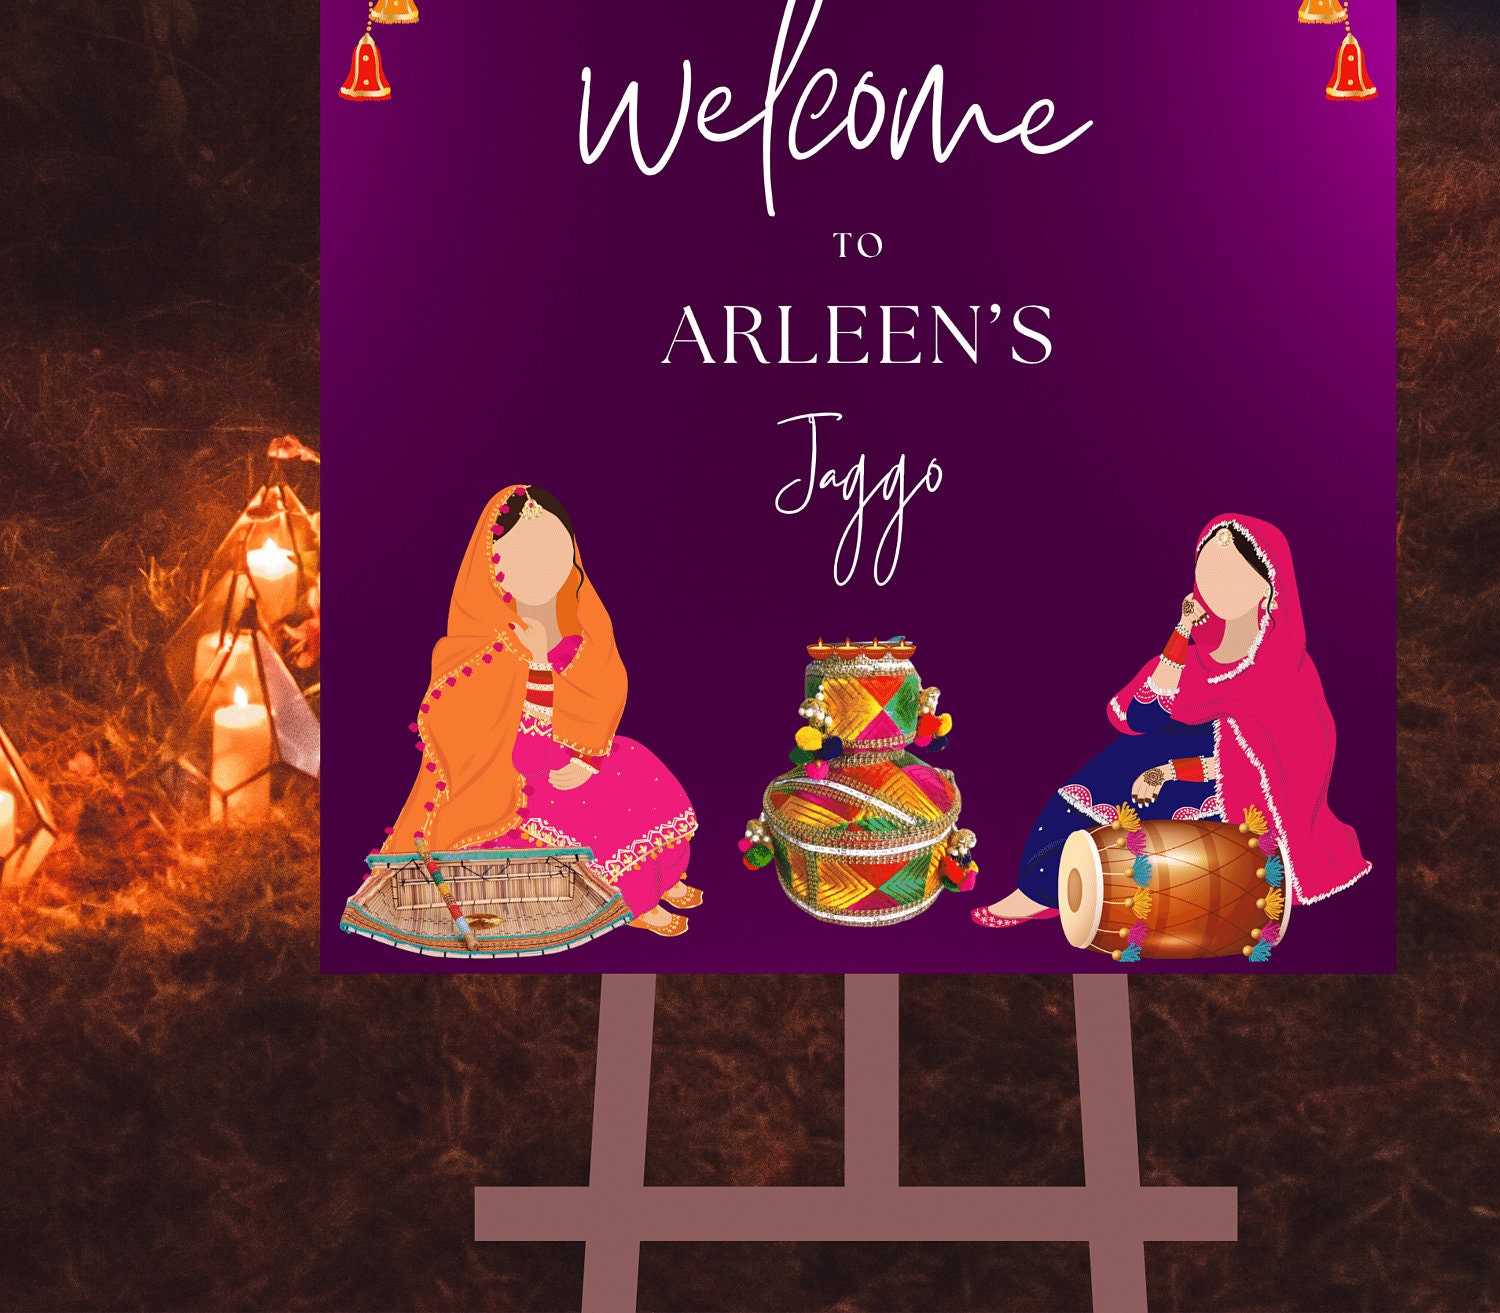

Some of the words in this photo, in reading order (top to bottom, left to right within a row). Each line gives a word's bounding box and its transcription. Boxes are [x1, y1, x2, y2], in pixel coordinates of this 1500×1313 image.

[832, 232, 884, 259] TO
[660, 303, 1053, 365] ARLEEN’S
[774, 412, 944, 587] Jaggo
